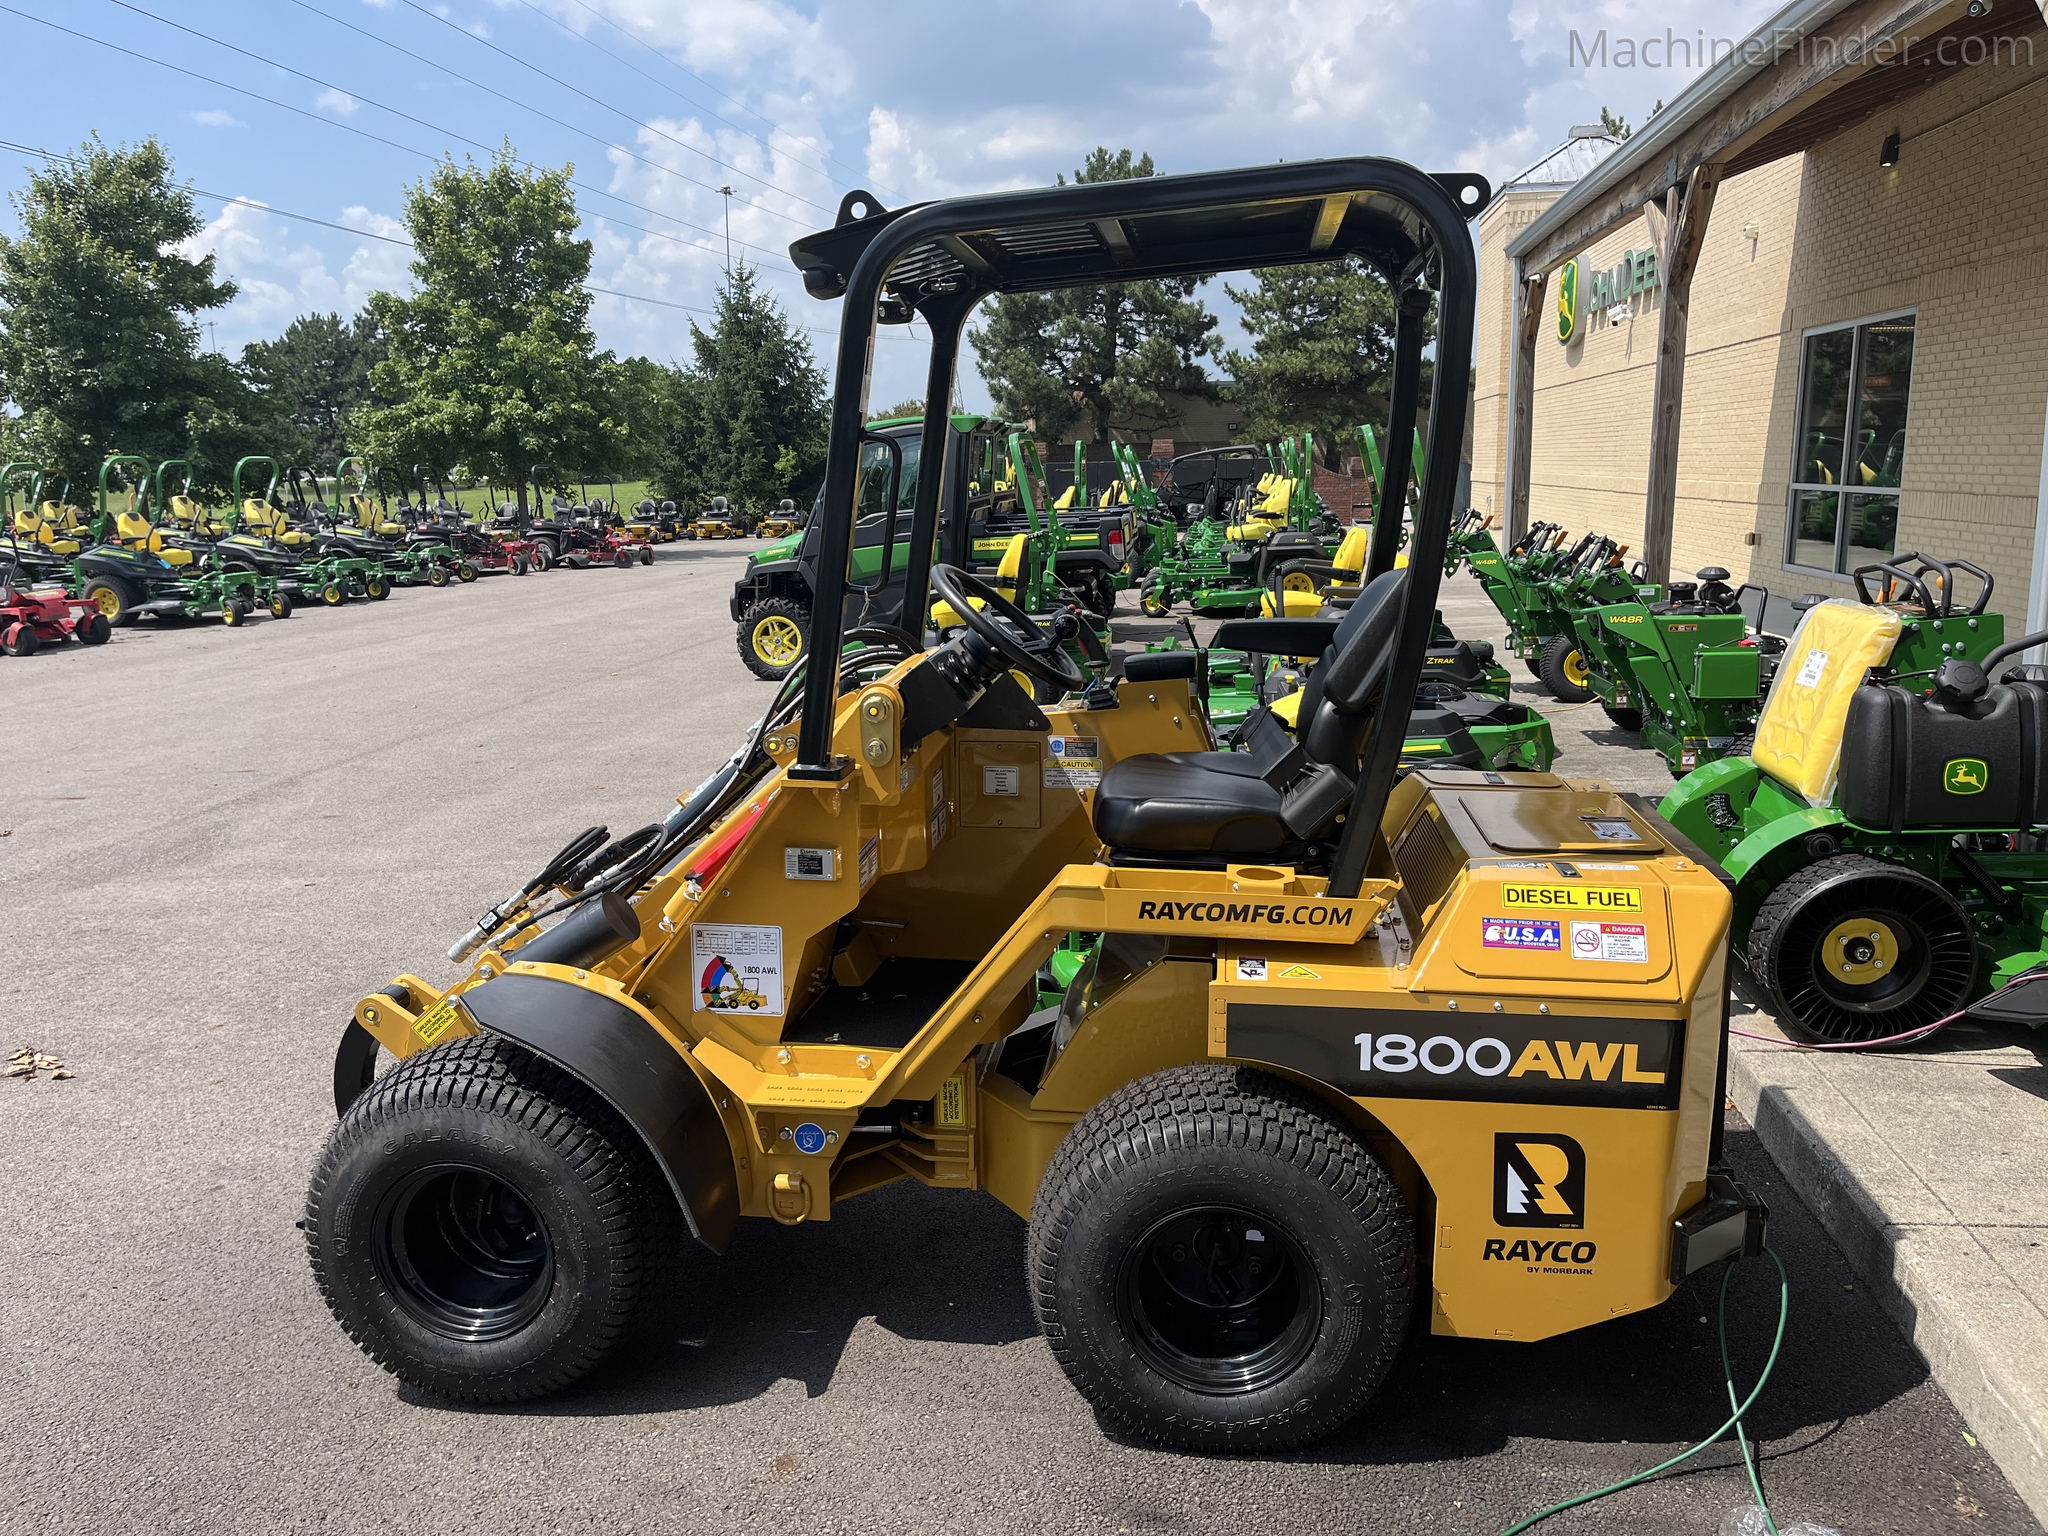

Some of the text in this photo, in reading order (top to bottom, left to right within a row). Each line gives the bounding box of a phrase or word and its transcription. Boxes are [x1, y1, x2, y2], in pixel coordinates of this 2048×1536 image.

[1621, 247, 1661, 299] DEE
[1609, 615, 1644, 625] W48R
[1426, 657, 1455, 665] ZTRAK
[1506, 888, 1638, 908] DIESEL FUEL
[1138, 901, 1353, 926] RAYCOMFG.COM
[1503, 926, 1559, 943] U.S.A.
[743, 965, 778, 975] 1800 AWL
[382, 1127, 515, 1155] GALAXY
[1482, 1239, 1597, 1264] RAYCO
[1543, 1267, 1593, 1275] MORBARK
